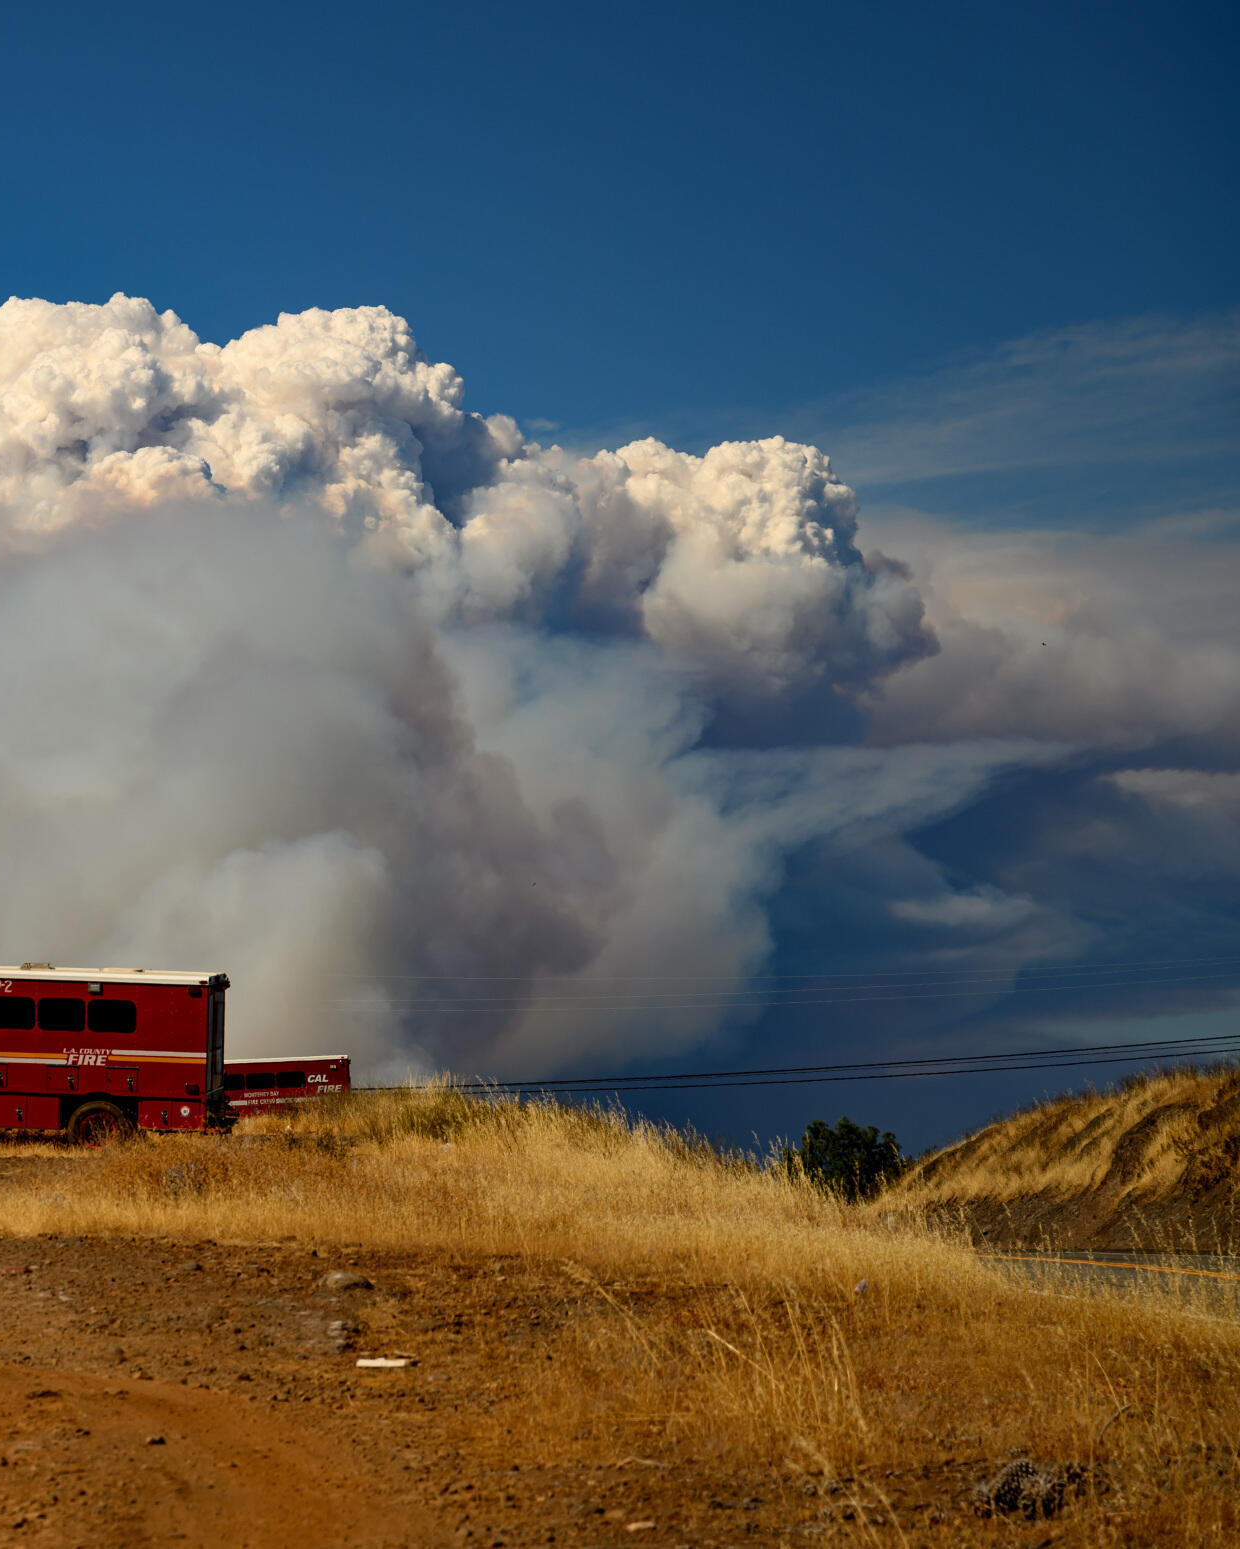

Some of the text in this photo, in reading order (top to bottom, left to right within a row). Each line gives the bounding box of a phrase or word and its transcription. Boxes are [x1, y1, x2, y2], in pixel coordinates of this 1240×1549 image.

[67, 1053, 108, 1066] FIRE
[307, 1074, 329, 1083] CAL
[317, 1084, 342, 1094] FIRE
